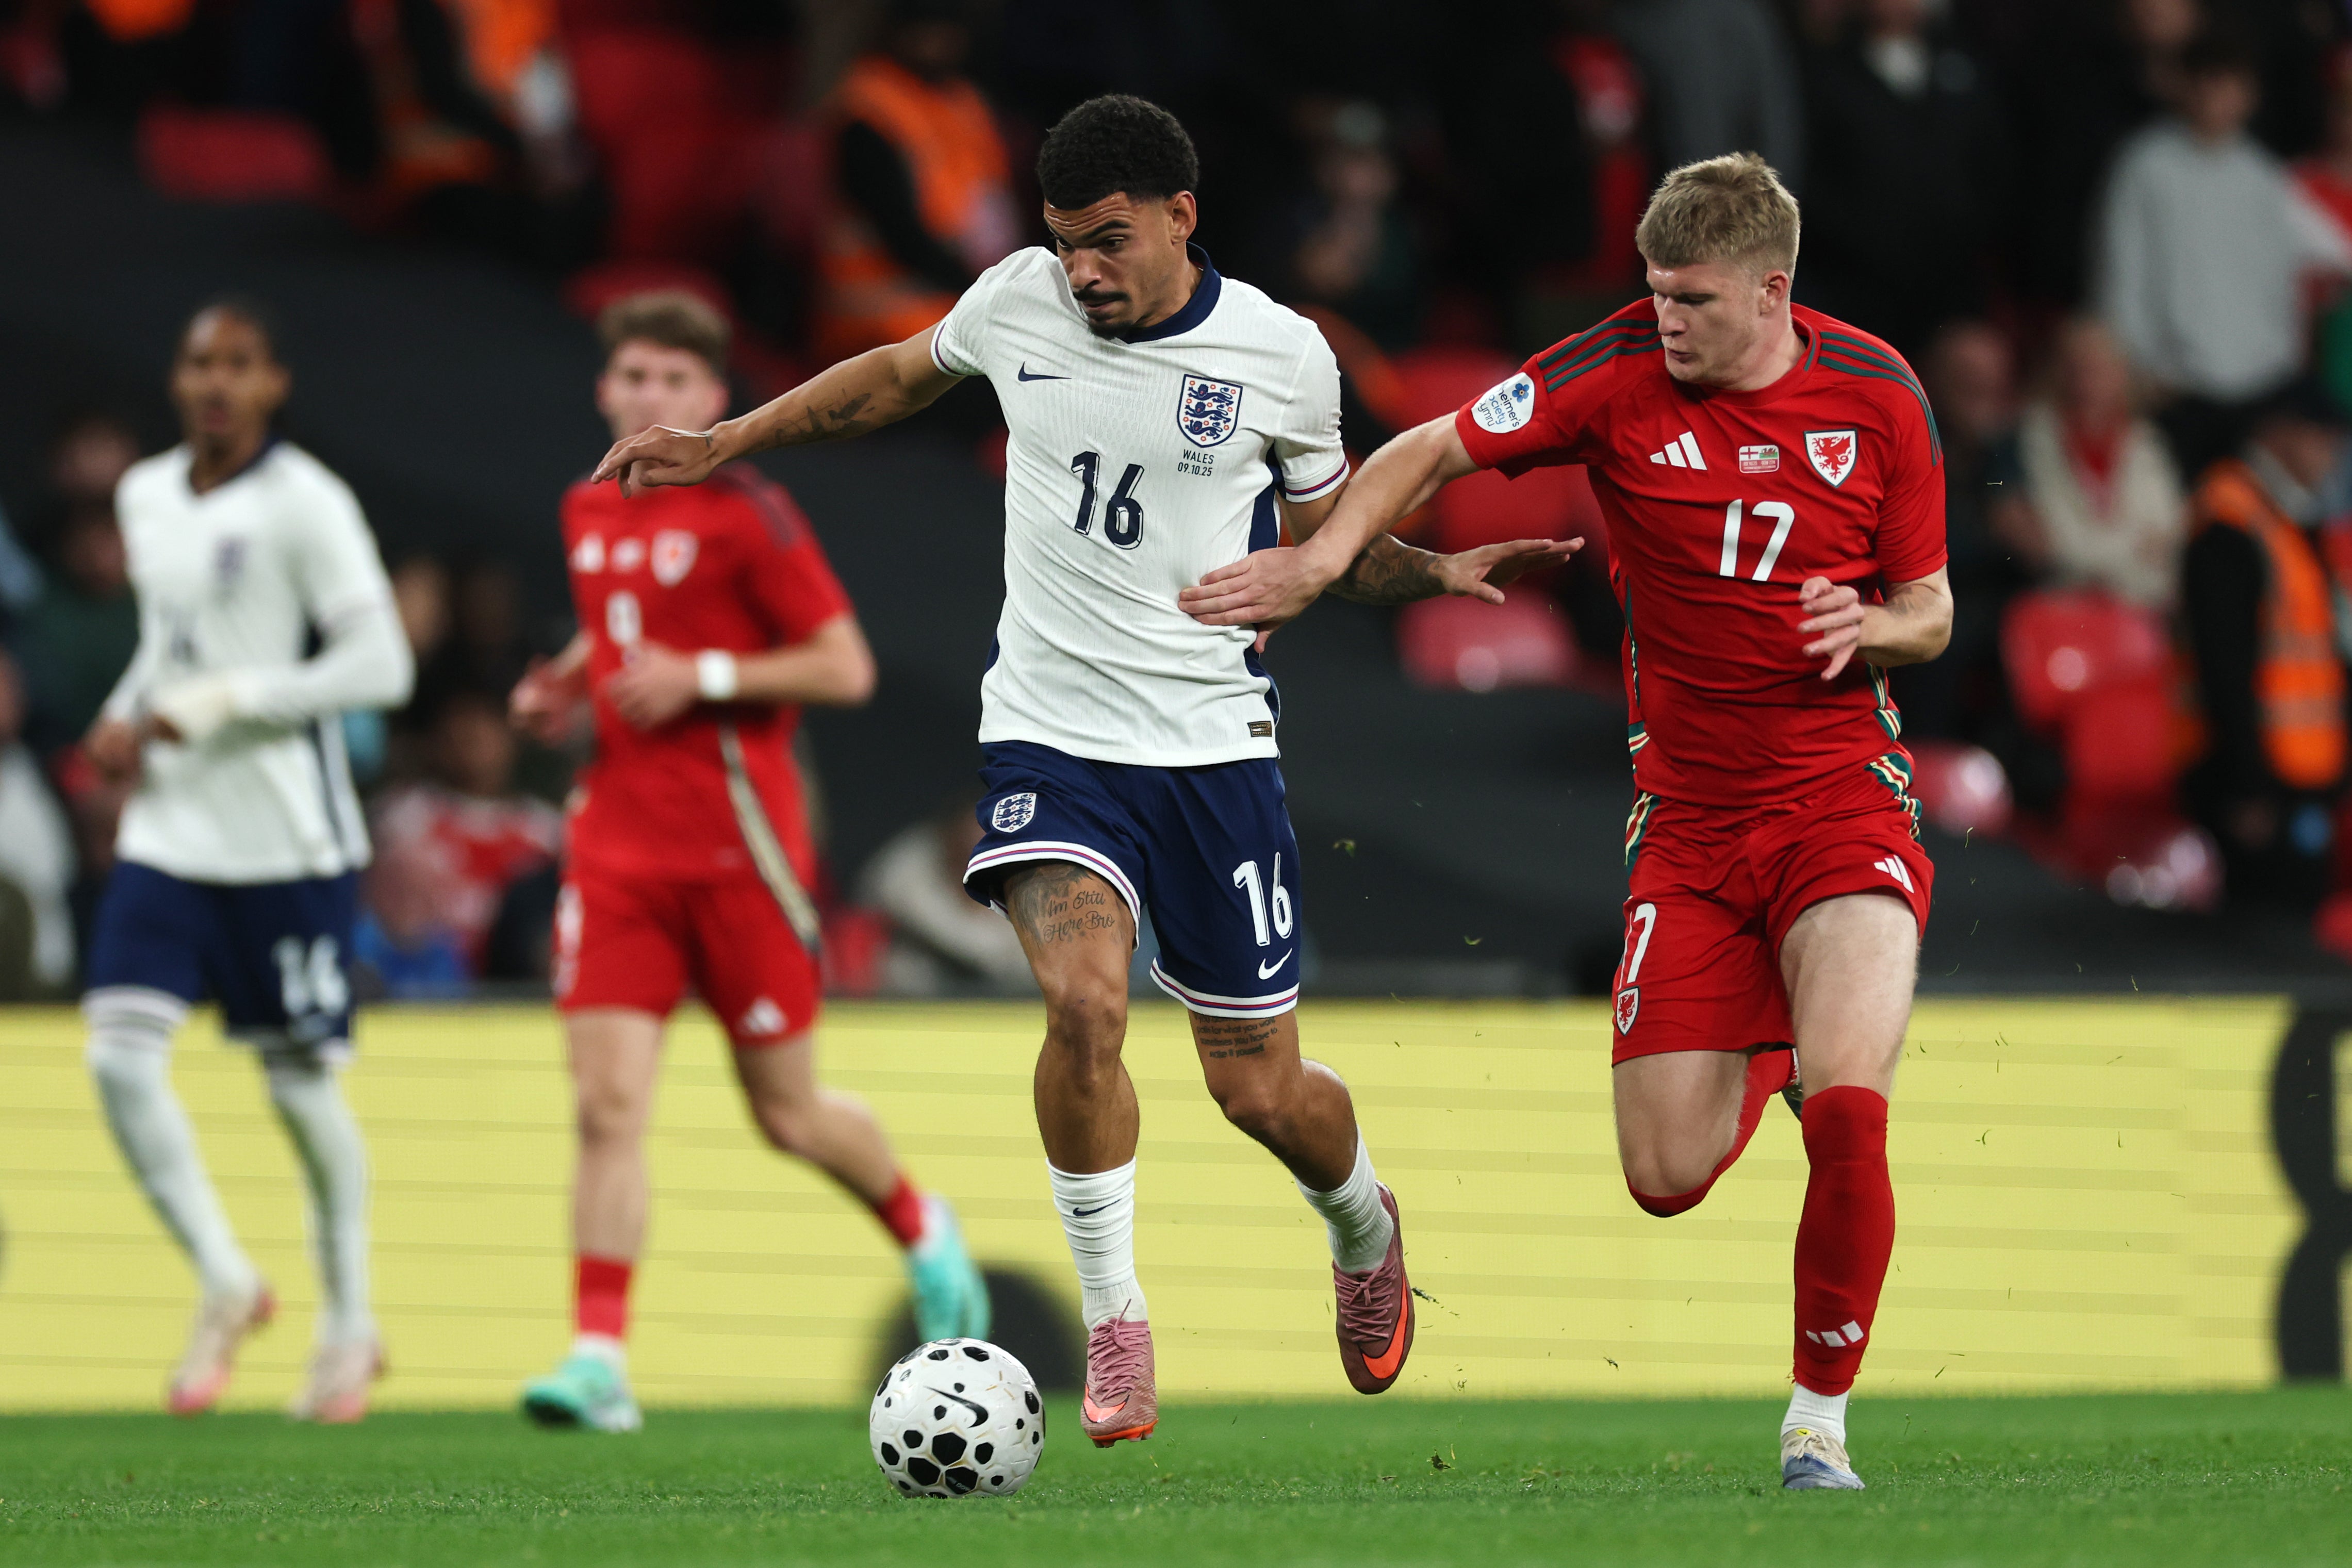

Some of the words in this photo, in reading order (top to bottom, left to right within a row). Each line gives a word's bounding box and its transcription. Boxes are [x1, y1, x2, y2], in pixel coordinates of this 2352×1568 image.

[1177, 461, 1213, 477] 09.10.25
[1182, 448, 1215, 465] WALES
[1070, 450, 1145, 550] 16
[1719, 498, 1796, 582] 17
[1048, 899, 1067, 918] I'm
[1072, 890, 1106, 910] Still
[1232, 851, 1293, 947] 16
[1043, 917, 1083, 944] Here
[1084, 910, 1115, 930] Bro
